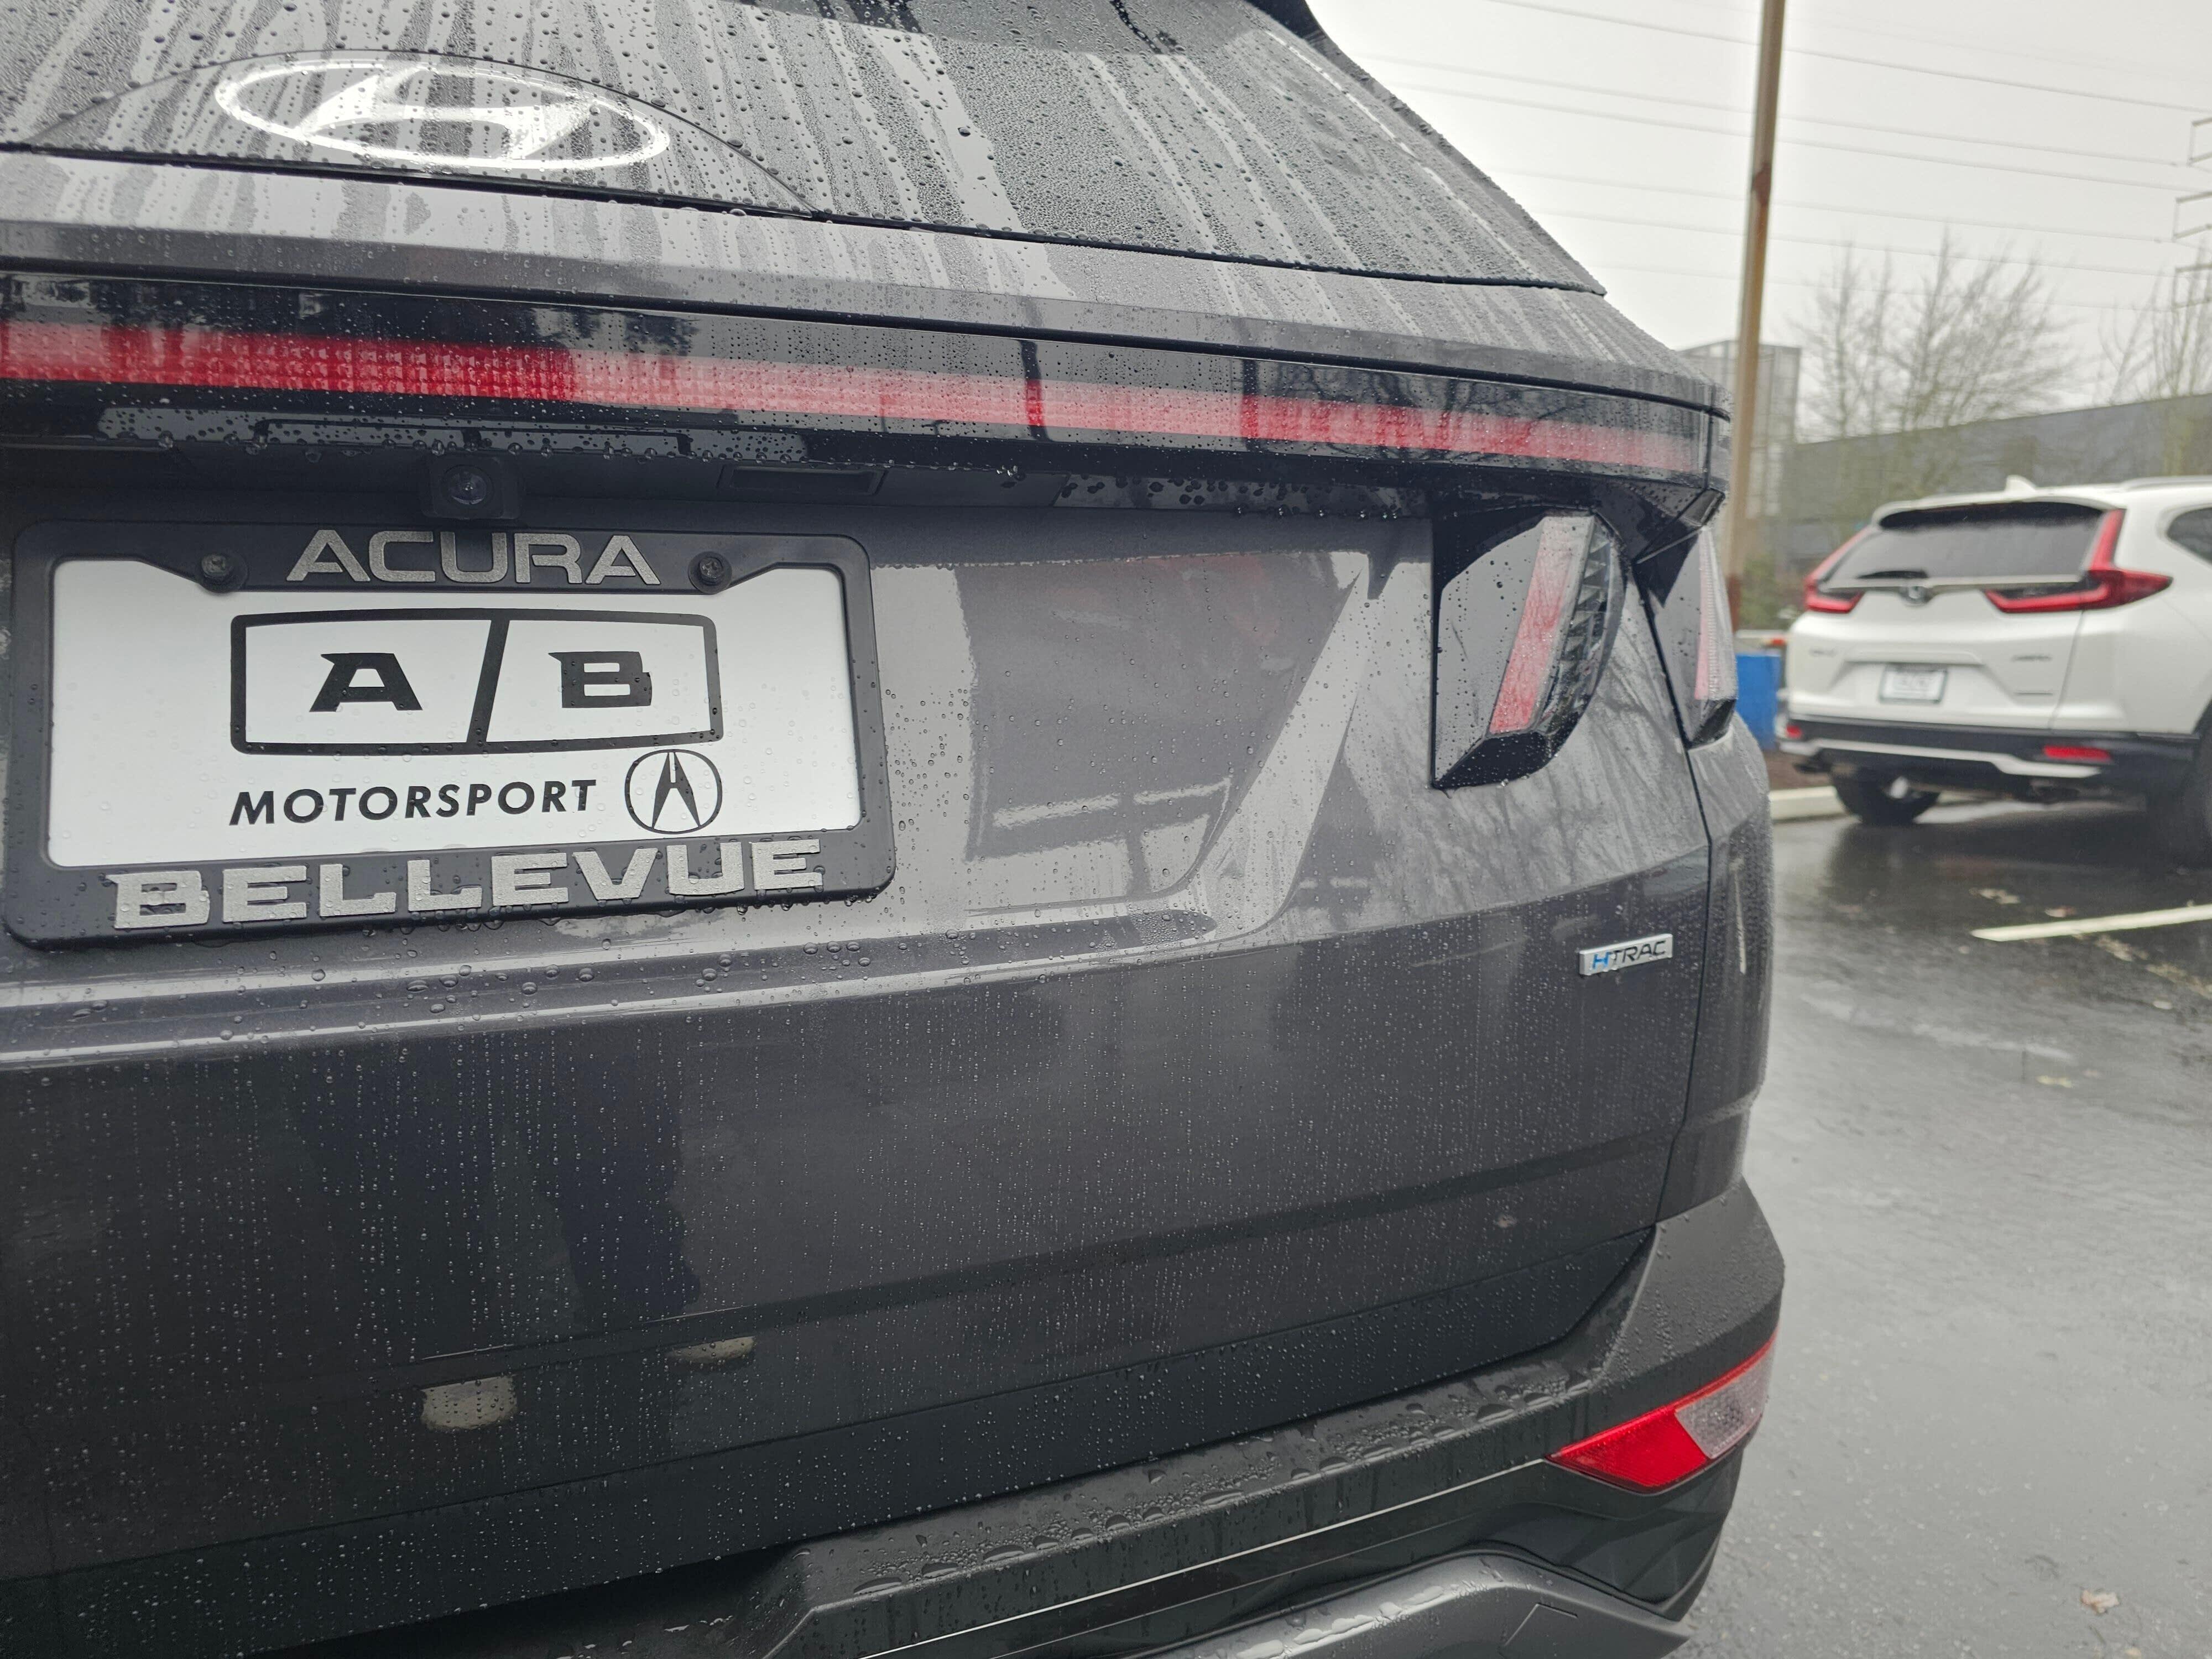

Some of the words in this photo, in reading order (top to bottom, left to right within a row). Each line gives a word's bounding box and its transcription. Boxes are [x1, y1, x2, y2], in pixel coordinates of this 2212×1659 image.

[286, 529, 662, 586] ACURA
[309, 653, 423, 713] A
[547, 650, 653, 709] B
[229, 779, 597, 826] MOTORSPORT
[107, 838, 824, 929] BELLEVUE
[1592, 940, 1666, 970] HTRAC
